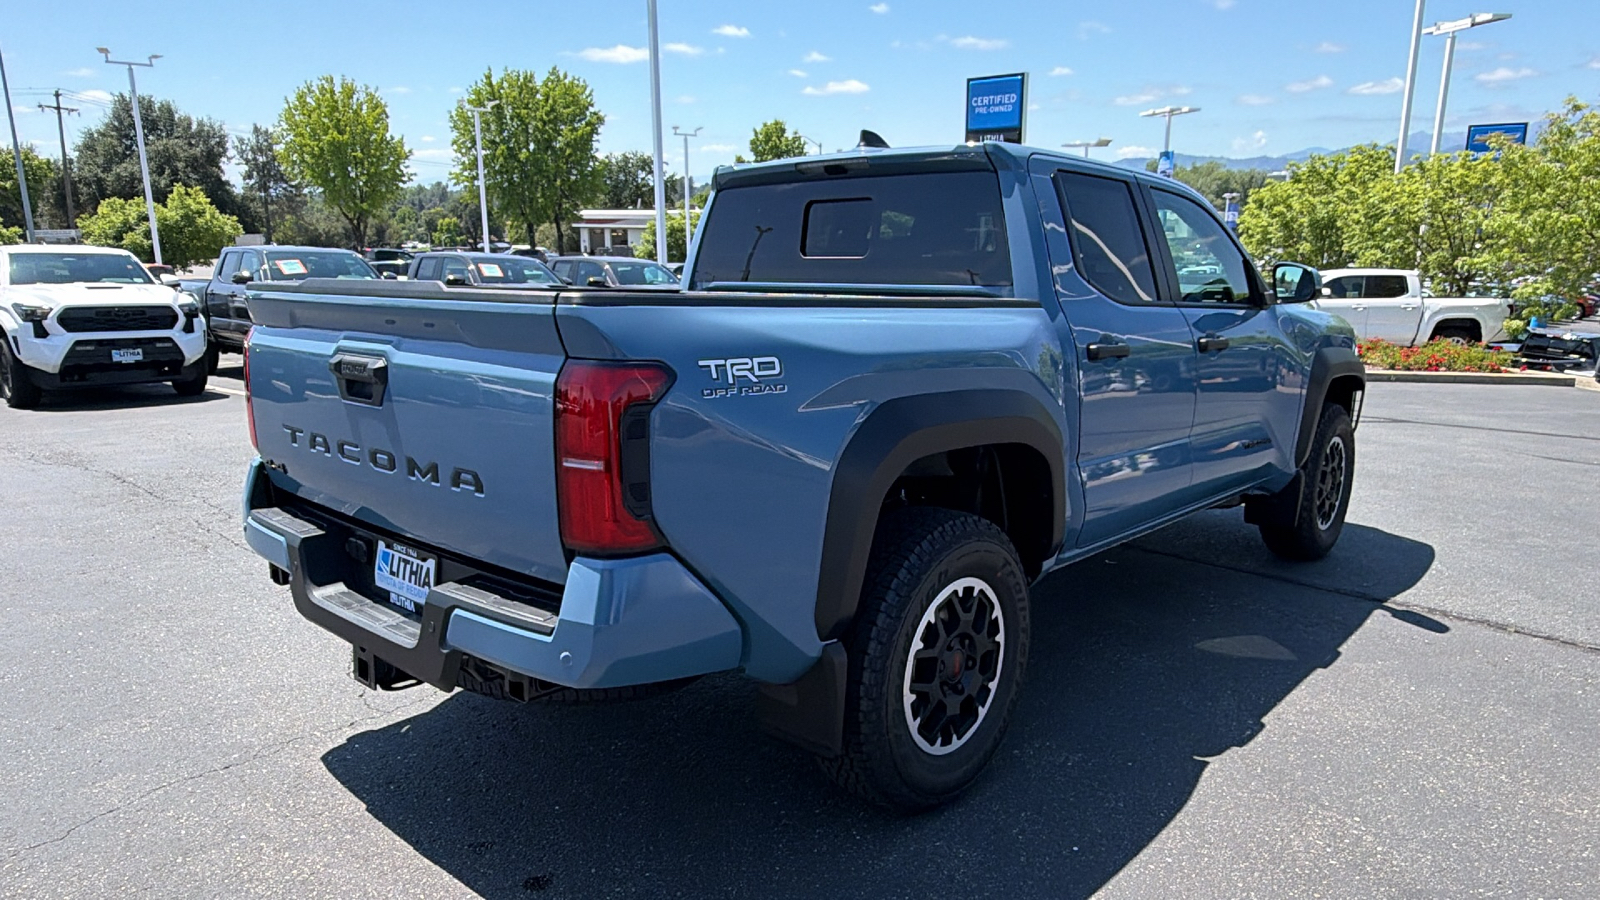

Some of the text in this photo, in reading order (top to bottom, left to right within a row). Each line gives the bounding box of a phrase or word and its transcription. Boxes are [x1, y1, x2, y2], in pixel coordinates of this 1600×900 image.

[972, 94, 1017, 106] CERTIFIED
[975, 105, 1012, 114] PRE-OWNED
[698, 356, 781, 384] TRD
[701, 384, 788, 399] OFF ROAD
[282, 424, 485, 497] TACOMA
[393, 543, 407, 554] SINCE
[389, 553, 431, 588] LITHIA
[395, 596, 415, 612] LITHIA
